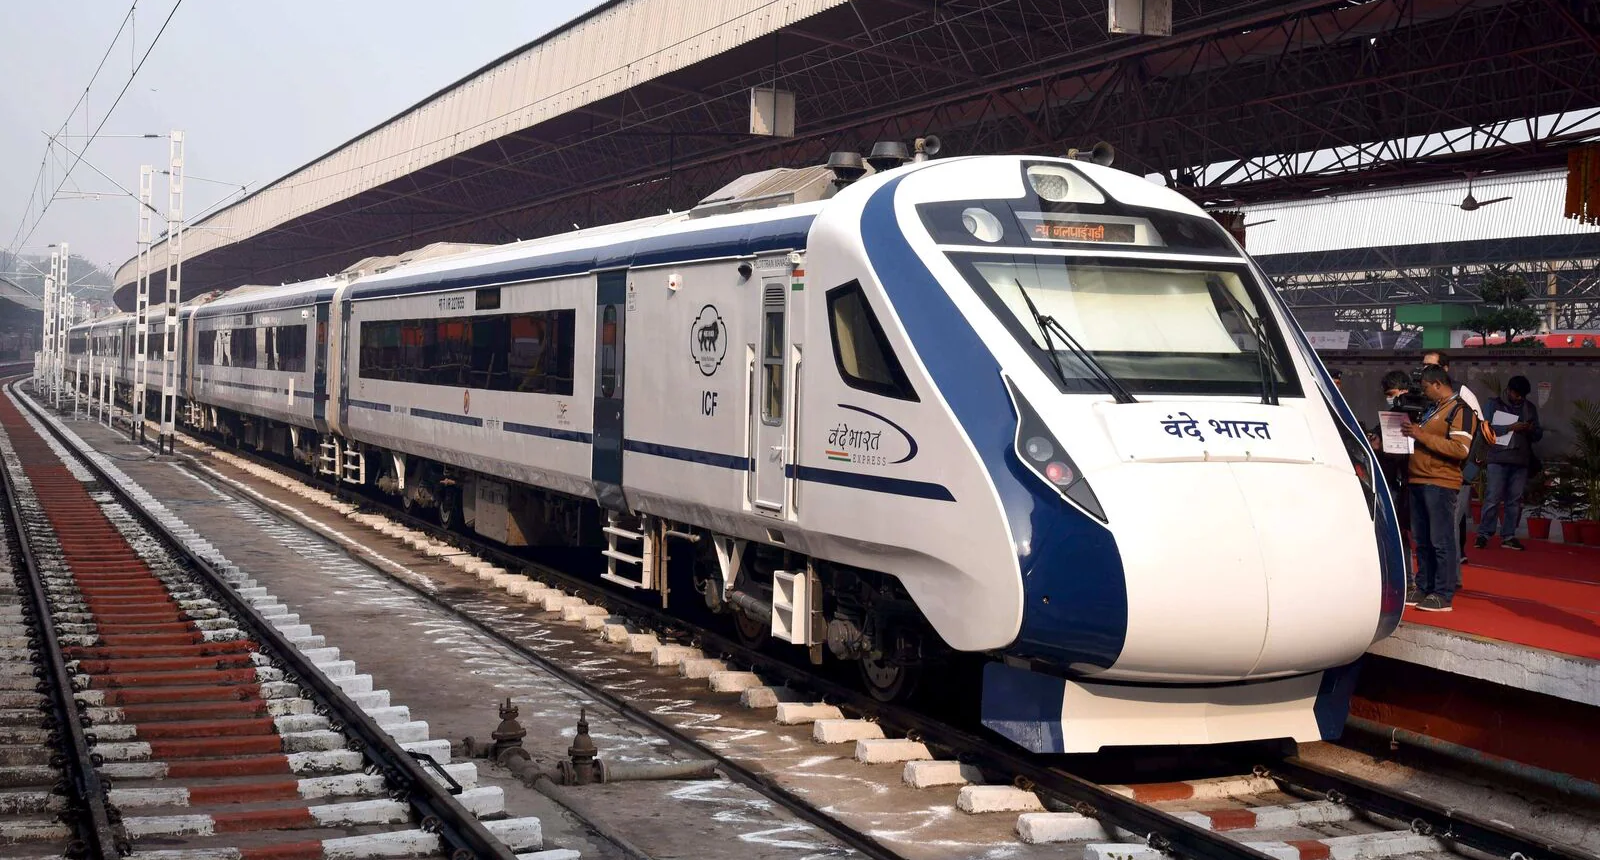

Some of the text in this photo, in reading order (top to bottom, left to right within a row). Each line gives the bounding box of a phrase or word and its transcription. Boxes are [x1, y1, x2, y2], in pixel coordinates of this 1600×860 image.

[701, 390, 718, 417] ICF
[1160, 411, 1272, 442] वंदे भारत
[852, 453, 887, 466] EXPRESS
